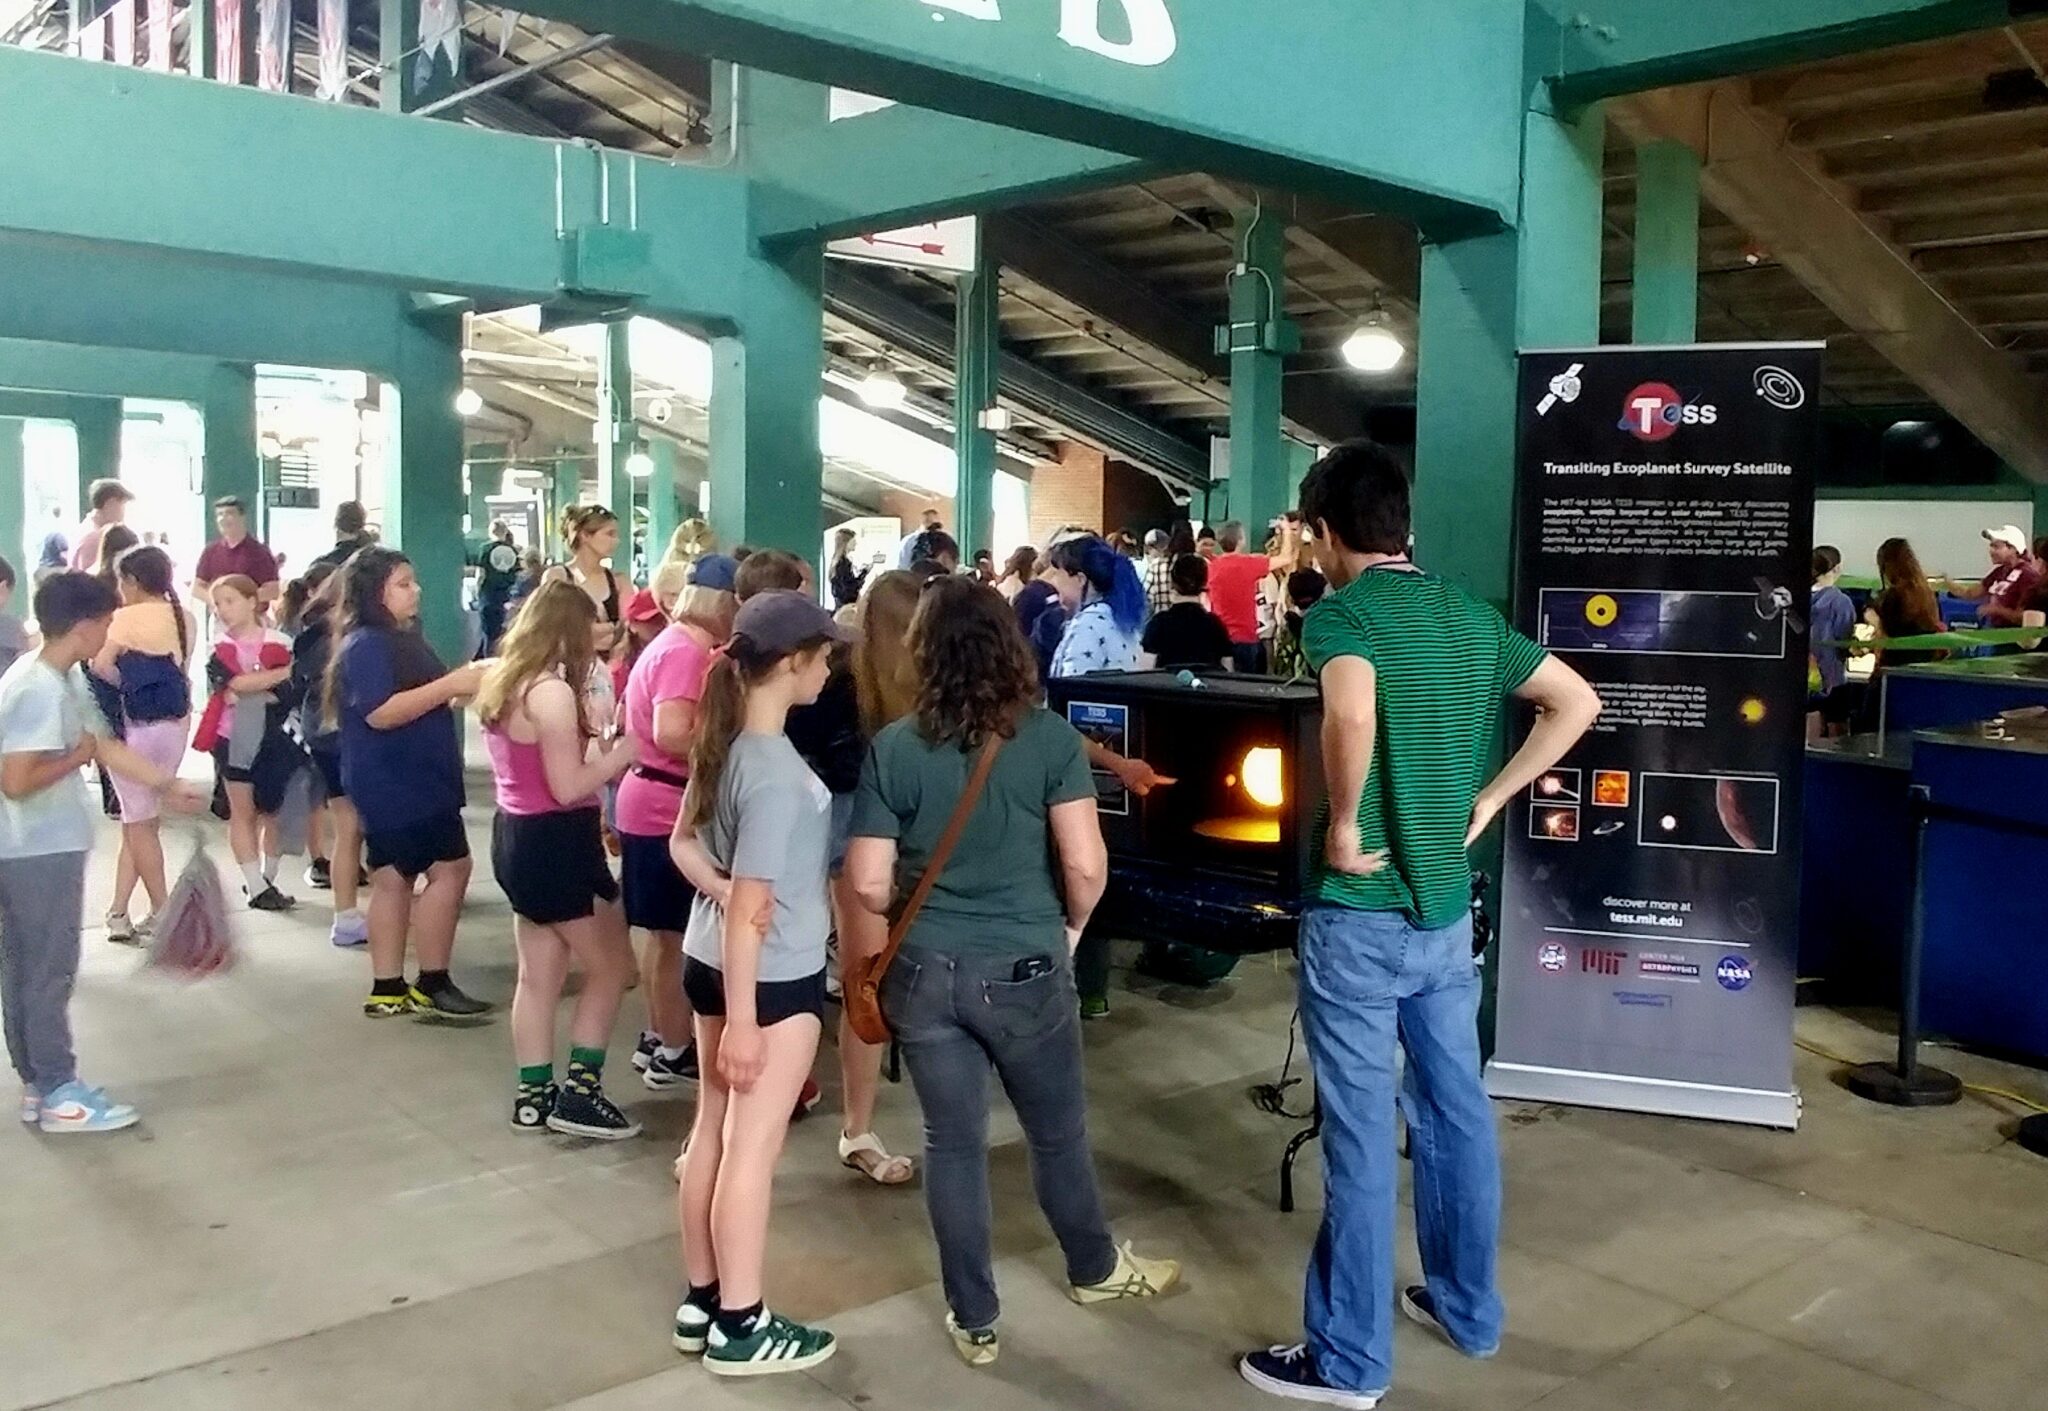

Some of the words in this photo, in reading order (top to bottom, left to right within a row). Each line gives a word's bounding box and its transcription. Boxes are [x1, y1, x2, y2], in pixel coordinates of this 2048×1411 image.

[1543, 462, 1610, 476] Transiting
[1613, 462, 1682, 476] Exoplanet
[1684, 462, 1731, 477] Survey
[1733, 463, 1792, 475] Satellite
[1603, 896, 1649, 909] discover
[1650, 901, 1679, 911] more
[1680, 902, 1692, 912] at
[1610, 911, 1683, 927] tess.mit.edu
[1717, 967, 1752, 980] NASA
